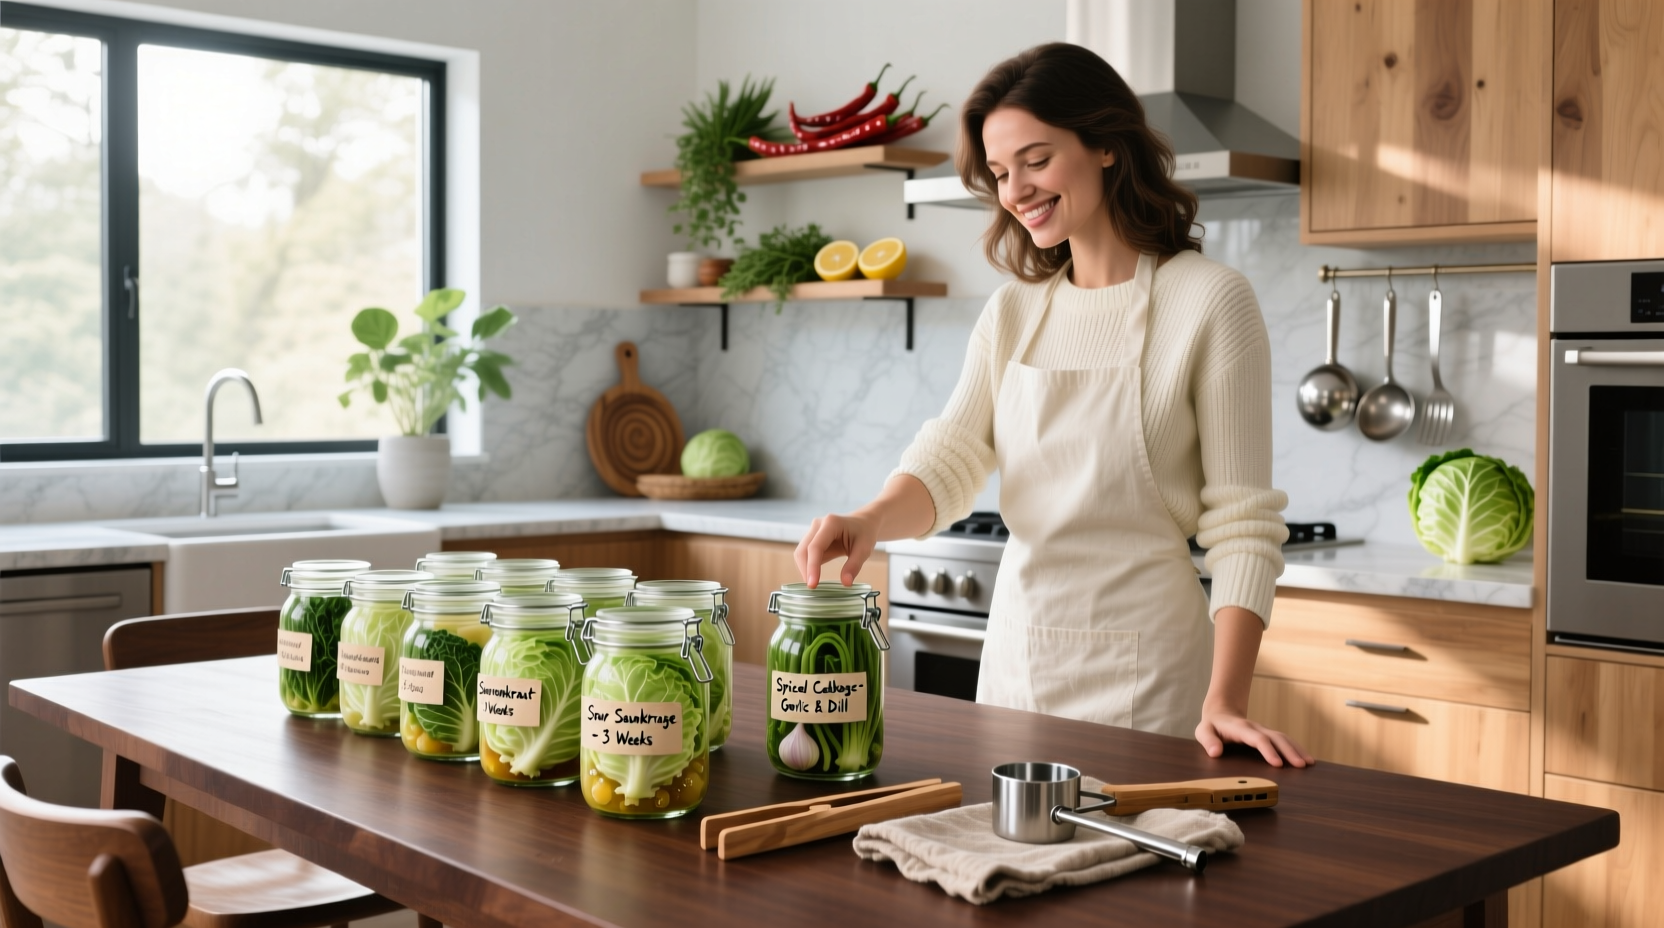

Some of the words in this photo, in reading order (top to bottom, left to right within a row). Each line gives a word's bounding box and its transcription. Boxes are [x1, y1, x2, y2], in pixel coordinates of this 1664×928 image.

[828, 698, 848, 713] Dill
[602, 729, 610, 745] 3
[616, 730, 653, 746] Weeks
